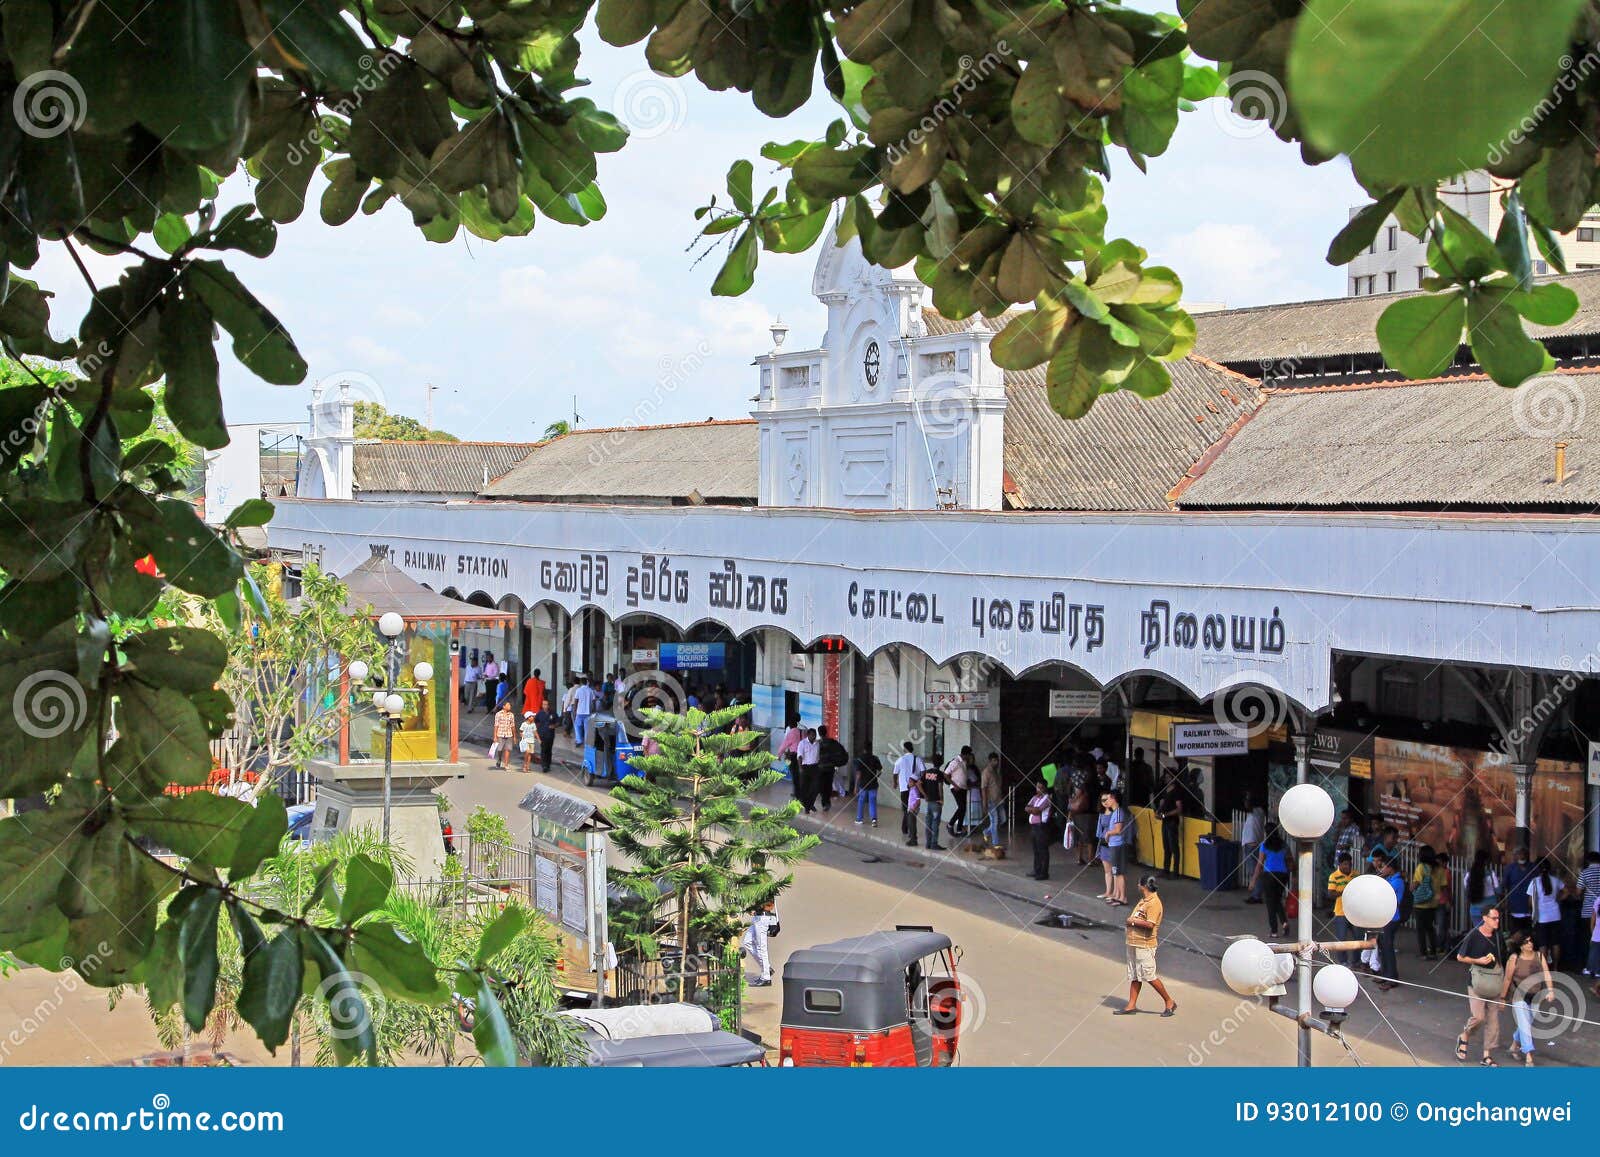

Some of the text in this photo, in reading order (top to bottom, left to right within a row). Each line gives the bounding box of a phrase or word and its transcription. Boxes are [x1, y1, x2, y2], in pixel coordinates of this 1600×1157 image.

[404, 550, 447, 573] RAILWAY
[457, 554, 509, 579] STATION
[972, 591, 1105, 652] புகையிரத
[1140, 599, 1287, 659] நிலையம்
[1183, 730, 1210, 738] RAILWAY
[1177, 740, 1245, 750] INFORMATION SERVICE
